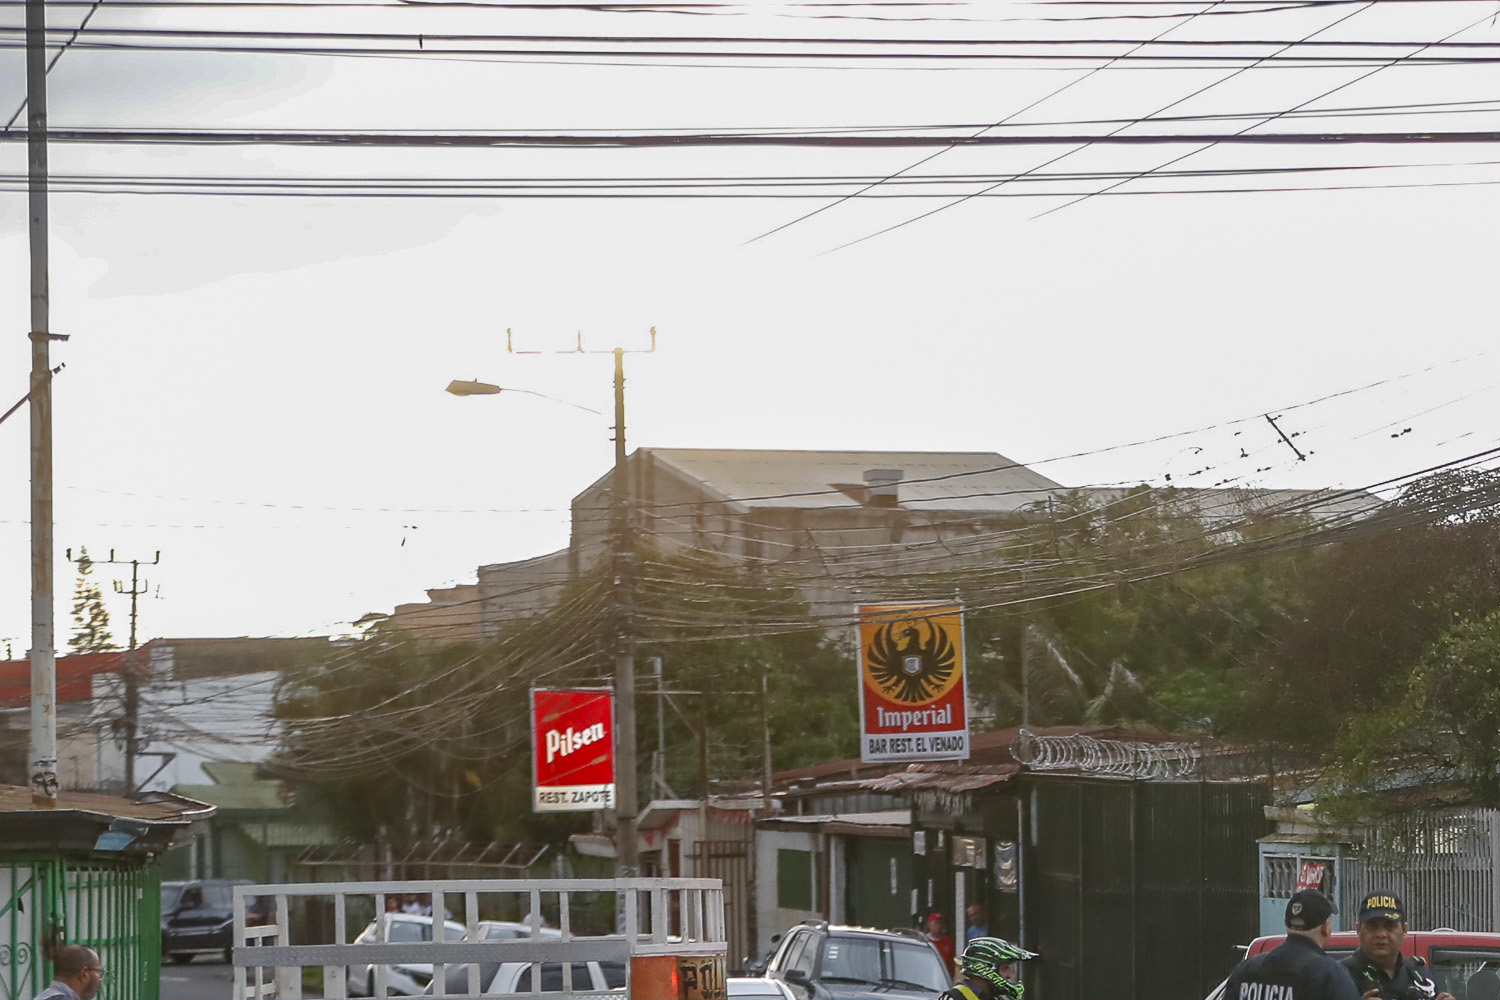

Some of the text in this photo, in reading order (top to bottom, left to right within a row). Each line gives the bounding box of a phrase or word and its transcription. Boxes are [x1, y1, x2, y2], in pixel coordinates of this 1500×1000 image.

[876, 703, 952, 731] Imperial
[545, 722, 605, 764] Pilsen
[869, 736, 964, 754] BAR REST. EL VENADO
[540, 790, 612, 804] REST. ZAPOTE
[1366, 896, 1397, 910] POLICIA
